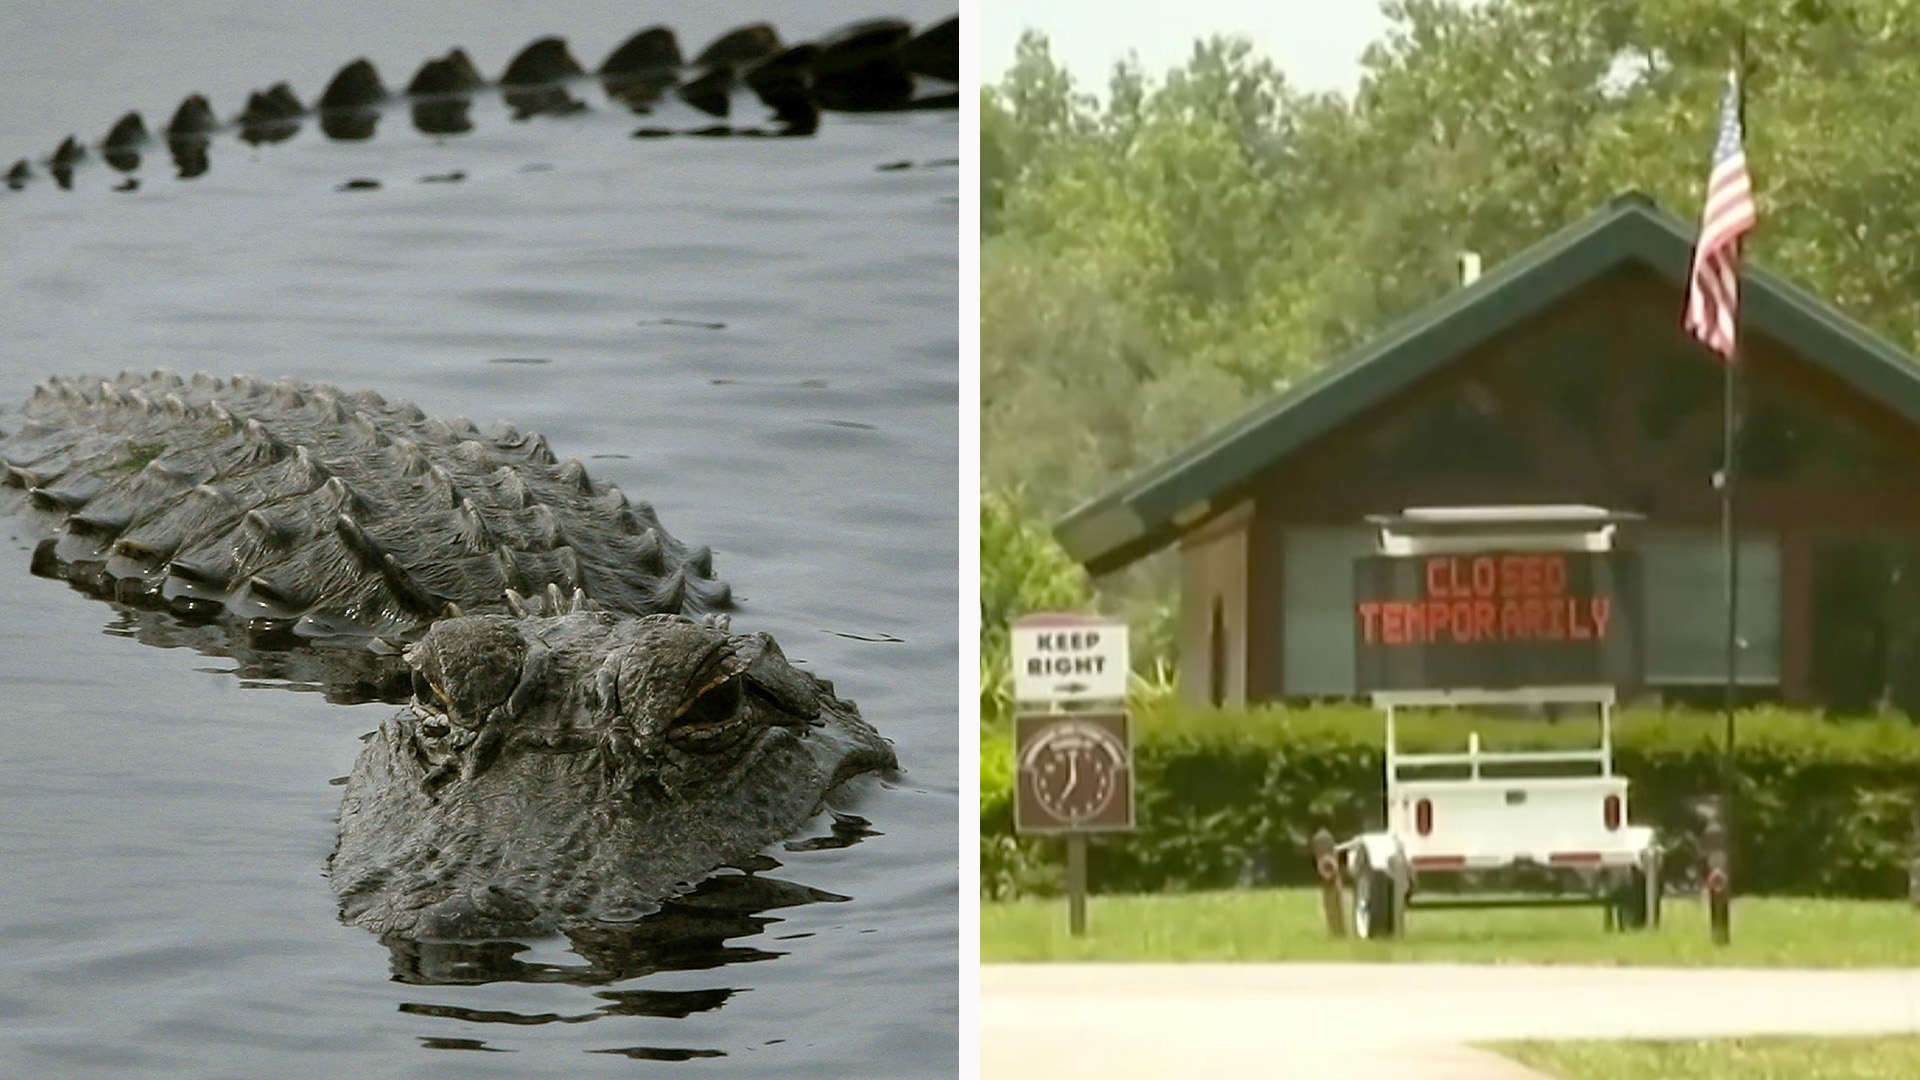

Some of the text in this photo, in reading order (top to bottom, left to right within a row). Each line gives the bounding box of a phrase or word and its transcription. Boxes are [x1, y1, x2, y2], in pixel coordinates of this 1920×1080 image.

[1426, 556, 1566, 598] CLOSED
[1358, 597, 1611, 644] TEMPORARILY
[1036, 632, 1101, 652] KEEP
[1027, 655, 1106, 677] RIGHT
